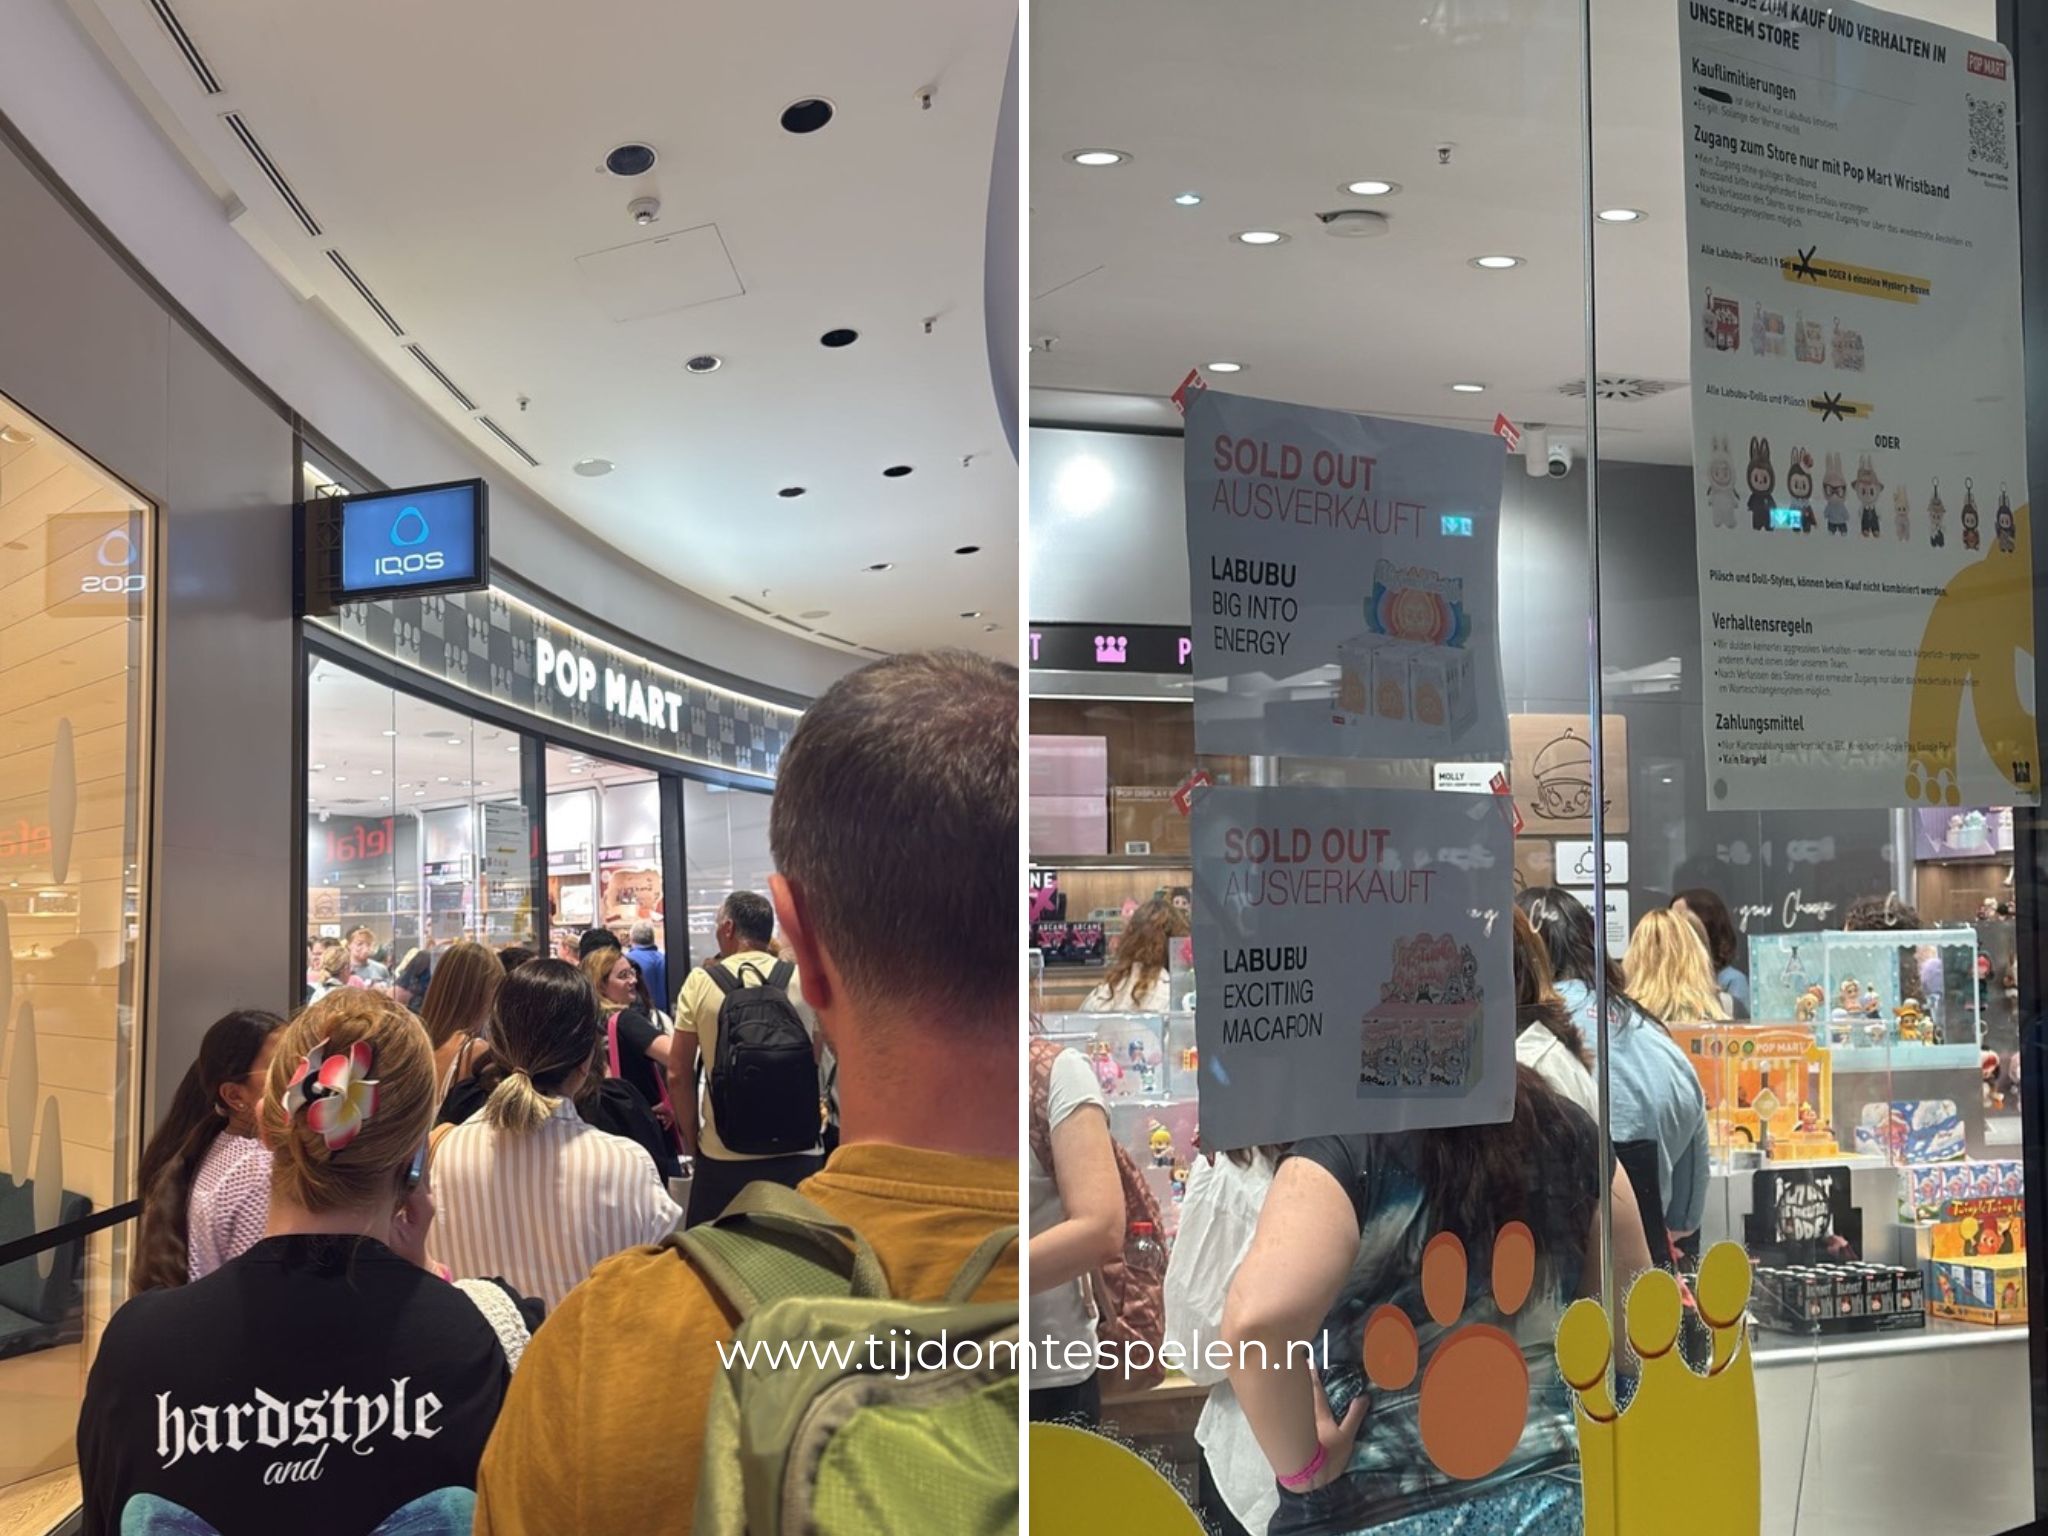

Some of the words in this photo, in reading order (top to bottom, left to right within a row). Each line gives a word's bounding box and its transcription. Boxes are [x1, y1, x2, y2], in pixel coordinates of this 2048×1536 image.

[1690, 2, 1754, 38] UNSEREM
[1758, 22, 1800, 50] STORE
[1791, 3, 1826, 29] KAUF
[1829, 12, 1854, 38] UND
[1856, 23, 1929, 60] VERHALTEN
[1933, 44, 1947, 64] IN
[1692, 57, 1796, 100] Kauflimitierungen
[1968, 54, 1983, 72] POP
[1984, 59, 2005, 78] MART
[1694, 124, 1737, 154] Zugang
[1740, 139, 1765, 157] zum
[1767, 143, 1797, 165] Store
[1799, 154, 1819, 170] nur
[1822, 158, 1841, 176] mit
[1843, 161, 1864, 183] Pop
[1867, 166, 1892, 188] Mart
[1894, 173, 1950, 200] Wristband
[1706, 384, 1720, 396] Alle
[1874, 434, 1901, 450] ODER
[1213, 434, 1302, 481] SOLD
[1313, 449, 1378, 491] OUT
[1212, 478, 1427, 538] AUSVERKAUFT
[374, 551, 445, 576] IQOS
[1211, 555, 1297, 588] LABUBU
[1709, 568, 1734, 583] Plüsch
[1736, 572, 1750, 584] und
[1825, 578, 1843, 590] beim
[1845, 579, 1862, 592] Kauf
[1863, 580, 1880, 592] nicht
[1882, 582, 1919, 596] kombiniert
[1212, 591, 1241, 618] BIG
[1248, 593, 1298, 623] INTO
[1712, 612, 1813, 637] Verhaltensregeln
[1214, 626, 1290, 656] ENERGY
[535, 637, 597, 702] POP
[604, 667, 683, 734] MART
[1715, 713, 1804, 735] Zahlungsmittel
[1439, 772, 1465, 781] MOLLY
[1224, 827, 1312, 864] SOLD
[1322, 827, 1391, 864] OUT
[1224, 870, 1437, 906] AUSVERKAUFT
[1224, 946, 1307, 974] LABUBU
[1224, 979, 1314, 1009] EXCITING
[1223, 1013, 1323, 1044] MACARON
[1757, 1042, 1776, 1054] POP
[155, 1376, 444, 1470] hardstyle
[263, 1443, 330, 1485] and
